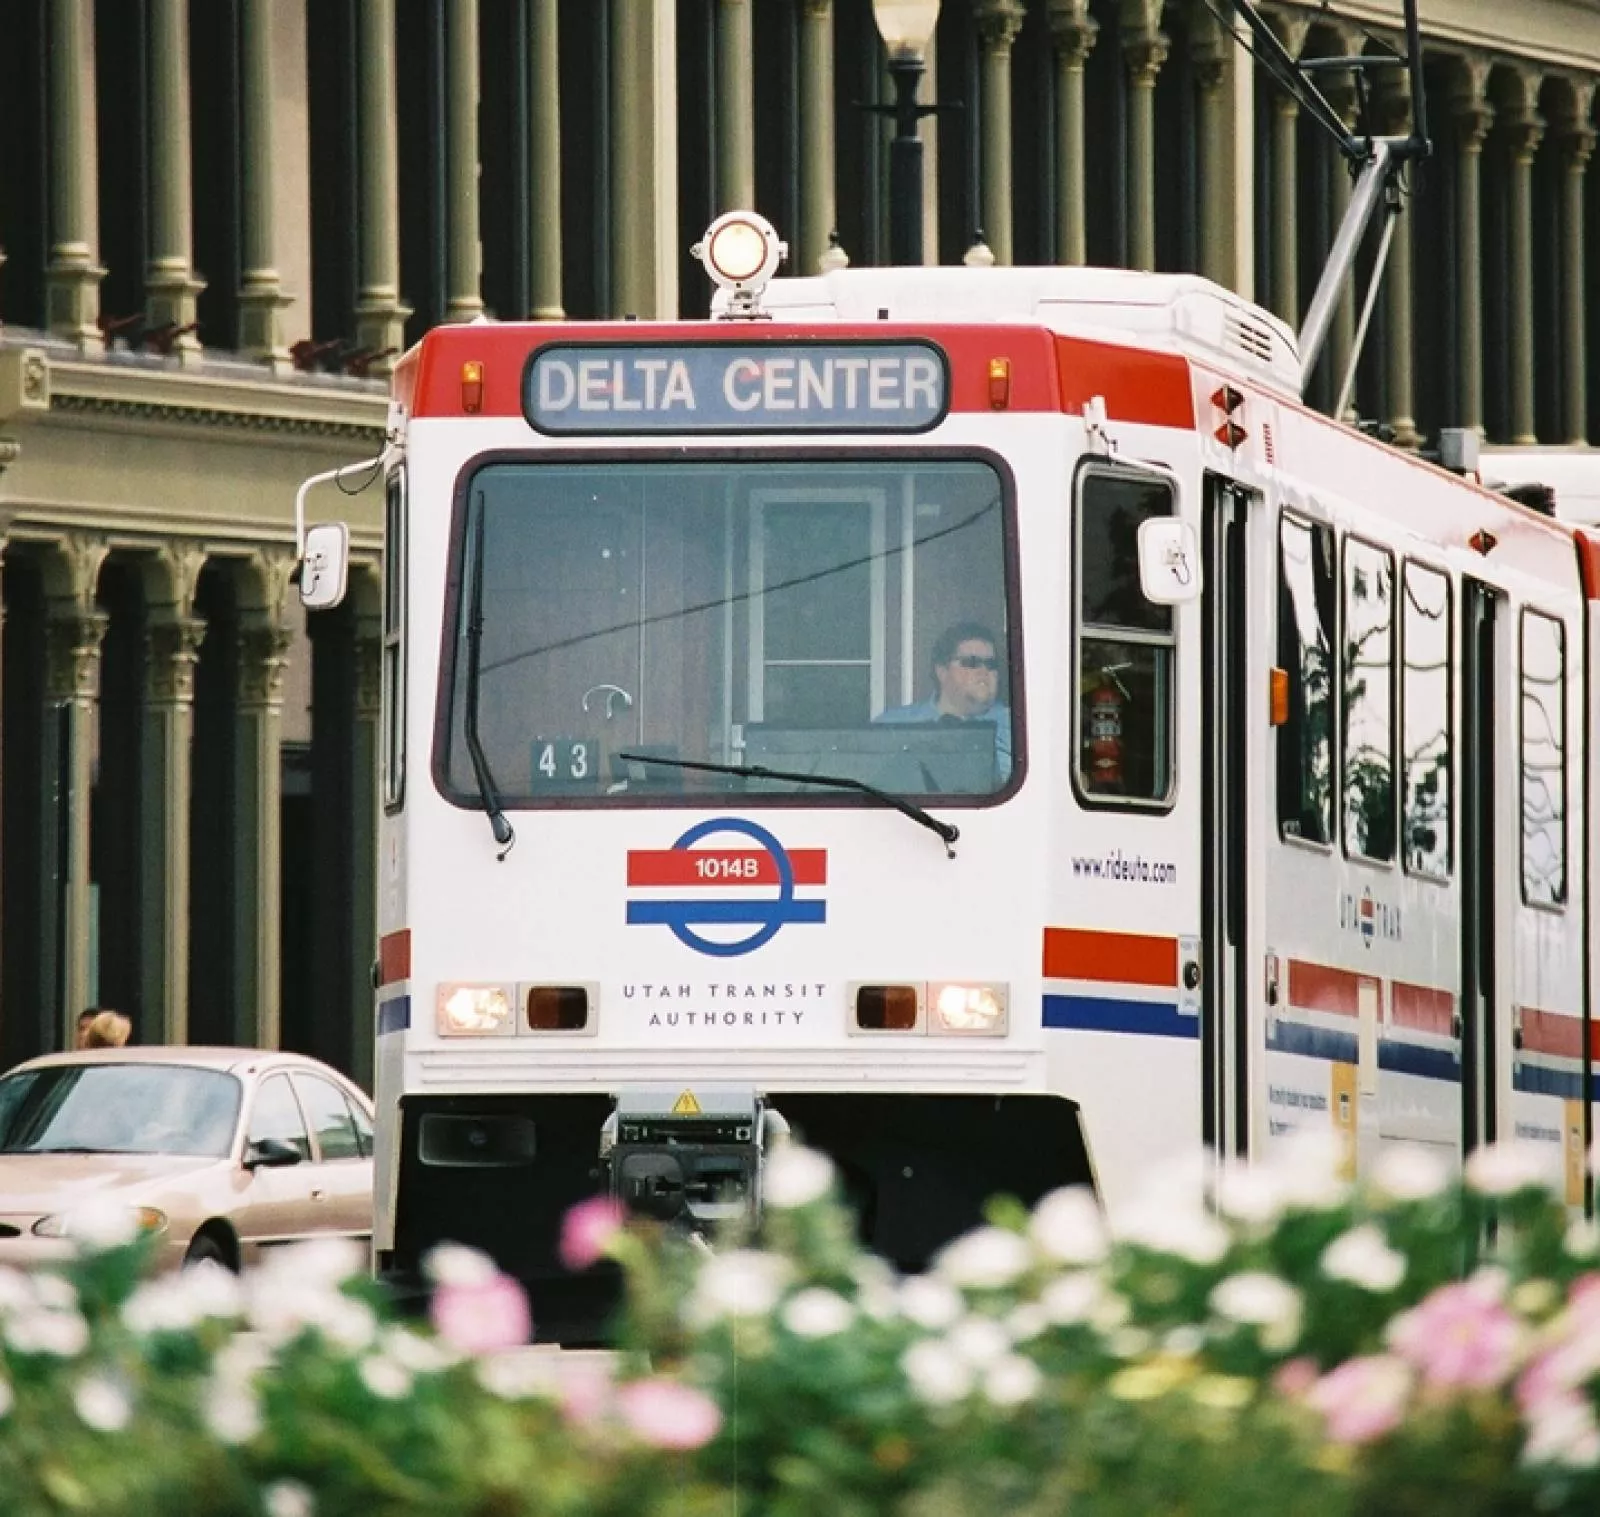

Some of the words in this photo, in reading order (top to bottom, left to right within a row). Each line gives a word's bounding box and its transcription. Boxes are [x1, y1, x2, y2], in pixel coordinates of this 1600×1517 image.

[540, 359, 696, 410] DELTA
[723, 357, 938, 409] CENTER
[695, 858, 759, 877] 1014B
[1071, 848, 1176, 883] www.rideuta.com
[623, 984, 691, 998] UTAH
[709, 984, 826, 998] TRANSIT
[649, 1012, 804, 1026] AUTHORITY
